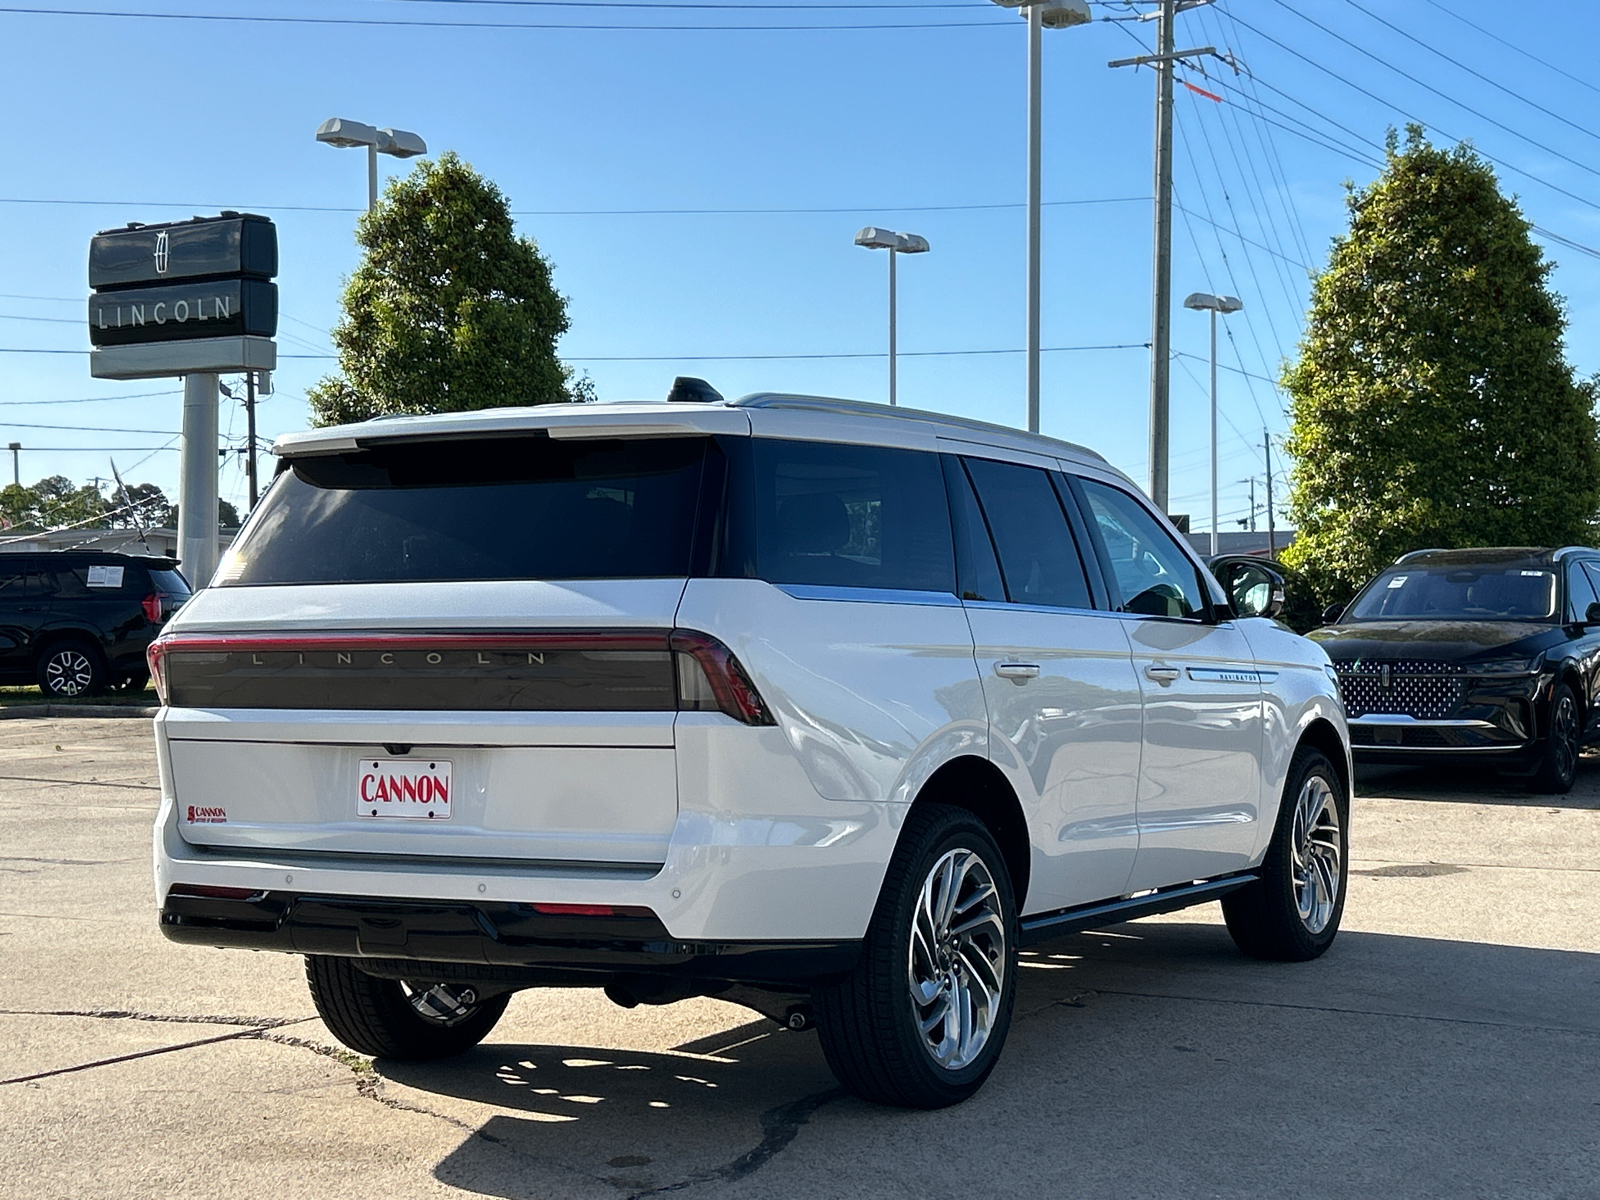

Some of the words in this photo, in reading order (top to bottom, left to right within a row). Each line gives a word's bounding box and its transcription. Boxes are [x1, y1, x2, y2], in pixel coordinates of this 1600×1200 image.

[99, 296, 230, 330] LINCOLN
[252, 652, 545, 665] LINCOLN
[361, 774, 449, 804] CANNON
[195, 806, 226, 817] CANNON
